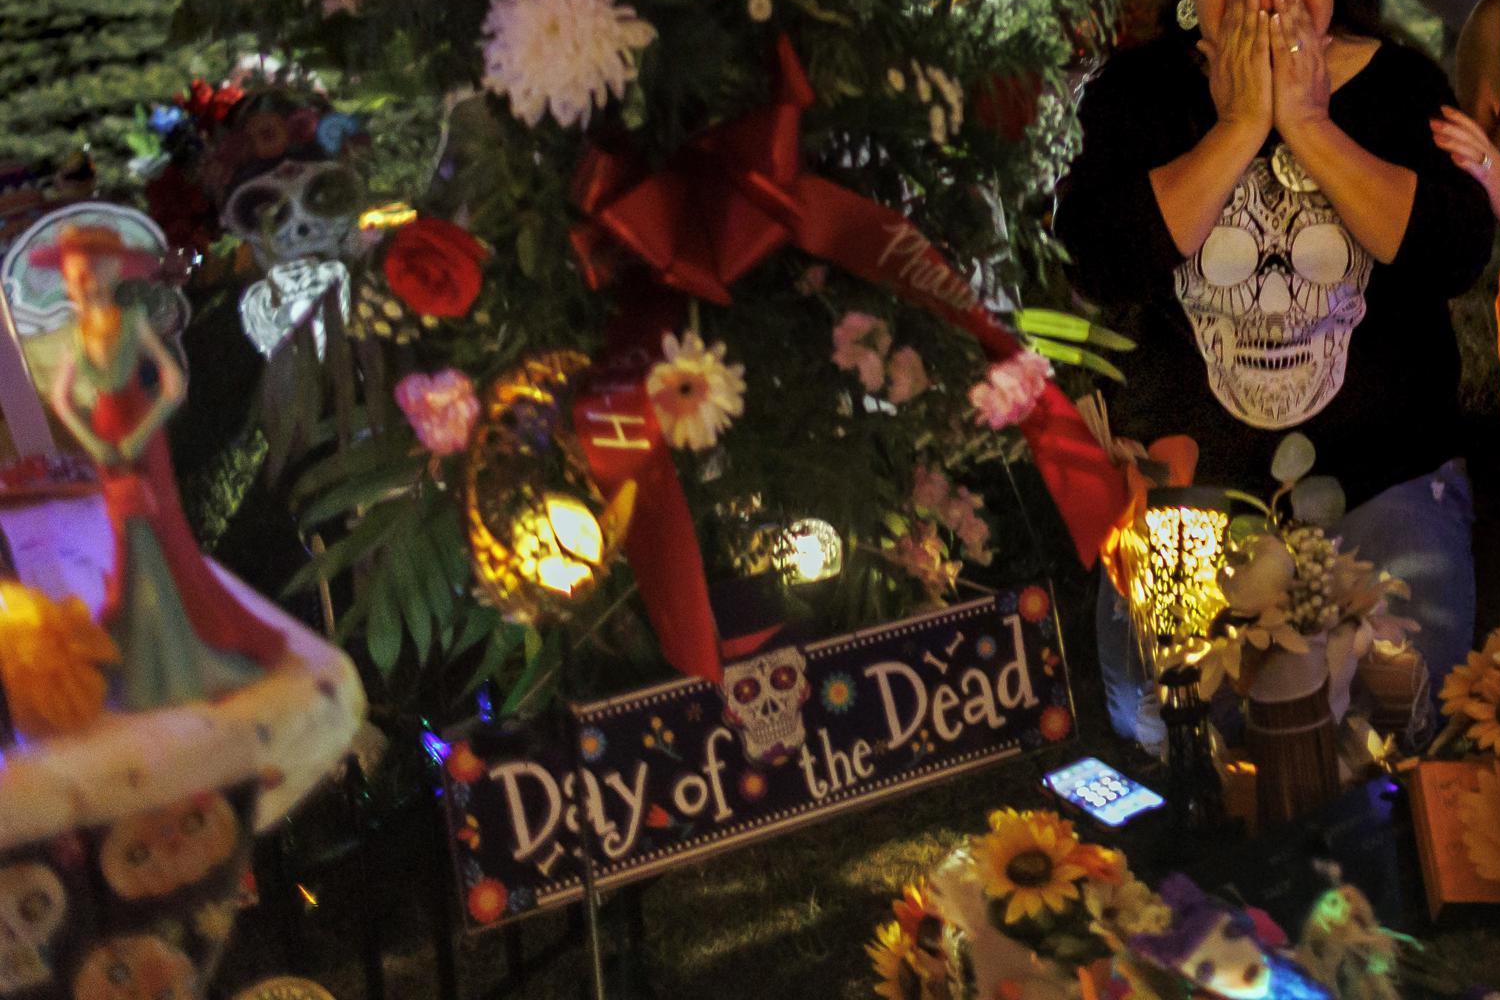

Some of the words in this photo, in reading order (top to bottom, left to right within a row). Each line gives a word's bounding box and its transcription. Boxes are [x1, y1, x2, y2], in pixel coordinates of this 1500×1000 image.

[488, 760, 649, 862] Day
[674, 726, 734, 822] of
[798, 727, 876, 800] the
[863, 613, 1040, 750] Dead
